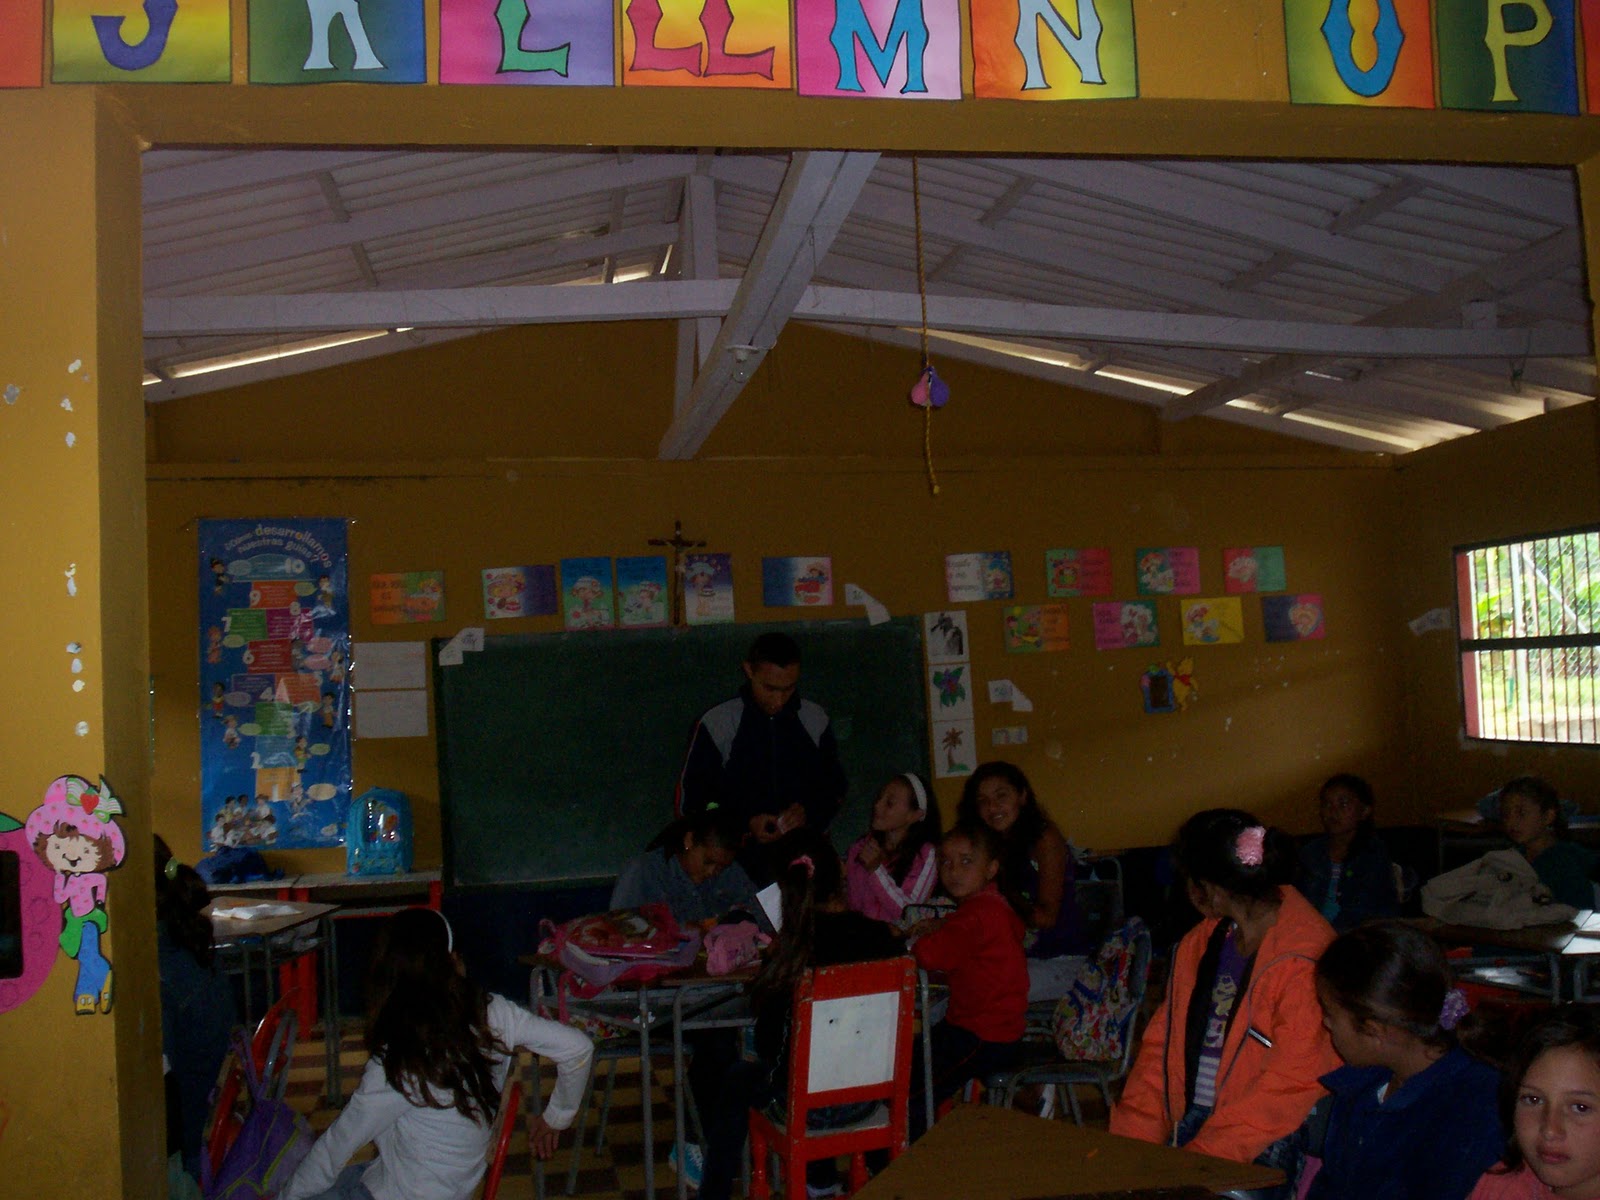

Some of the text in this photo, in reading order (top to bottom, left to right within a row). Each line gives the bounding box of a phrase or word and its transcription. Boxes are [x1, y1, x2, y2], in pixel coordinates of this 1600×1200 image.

[830, 0, 929, 94] M
[1014, 0, 1107, 90] N
[1484, 0, 1554, 102] P
[237, 537, 284, 554] nuestras
[255, 523, 333, 568] desarrollamos
[284, 557, 306, 574] 10
[249, 590, 261, 607] 9
[221, 616, 232, 632] 7
[259, 687, 273, 701] 4
[251, 751, 263, 769] 2
